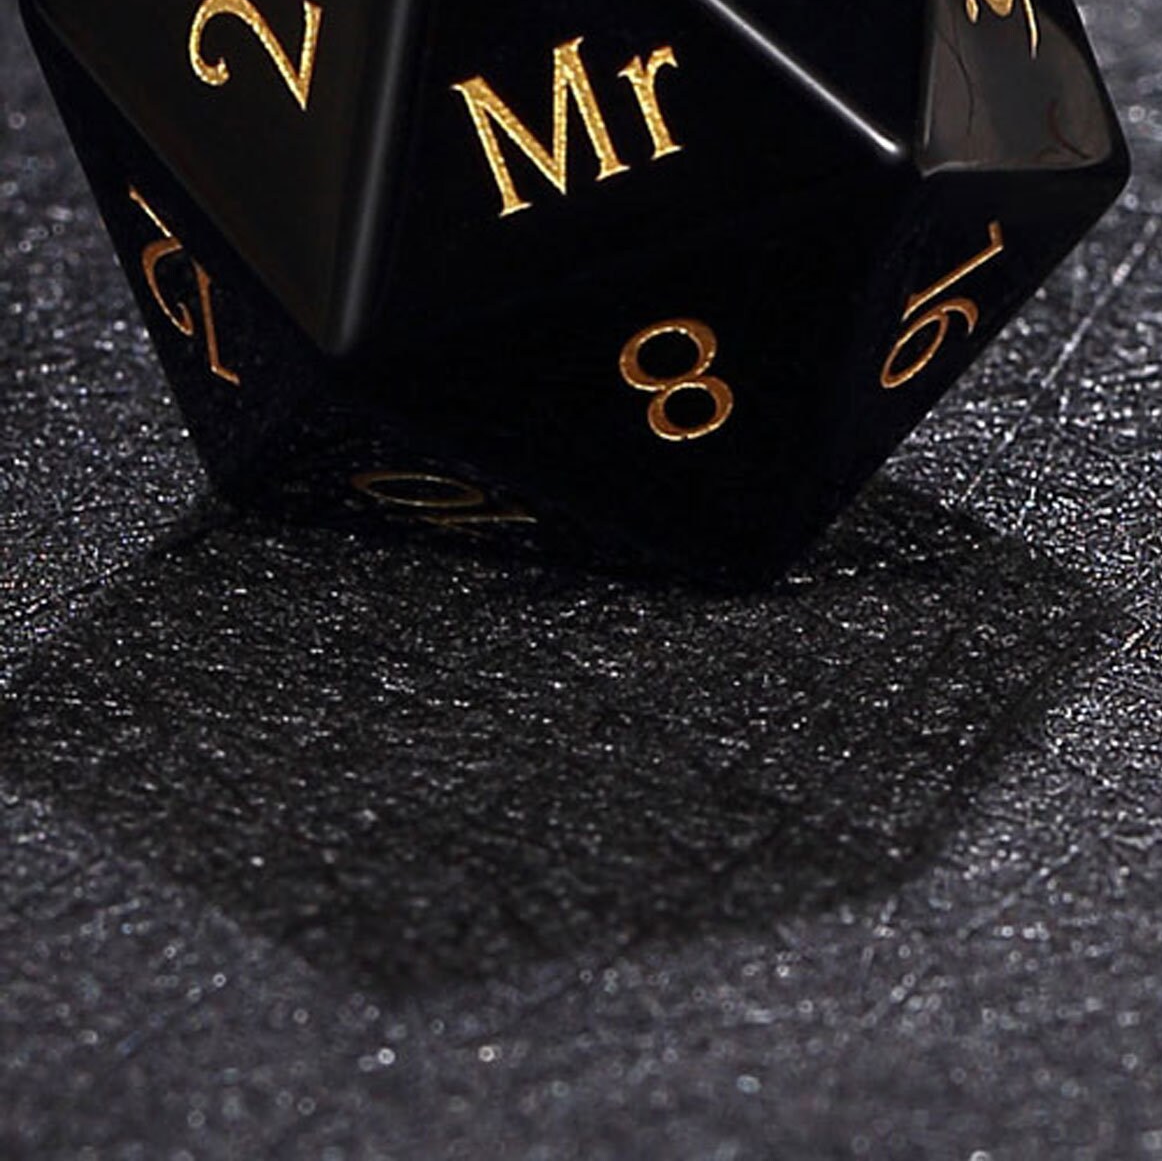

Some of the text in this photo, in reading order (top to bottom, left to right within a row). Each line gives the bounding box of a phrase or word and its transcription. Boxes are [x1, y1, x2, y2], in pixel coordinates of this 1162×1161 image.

[450, 36, 683, 217] Mr
[618, 318, 735, 441] 8
[880, 220, 1004, 389] 16
